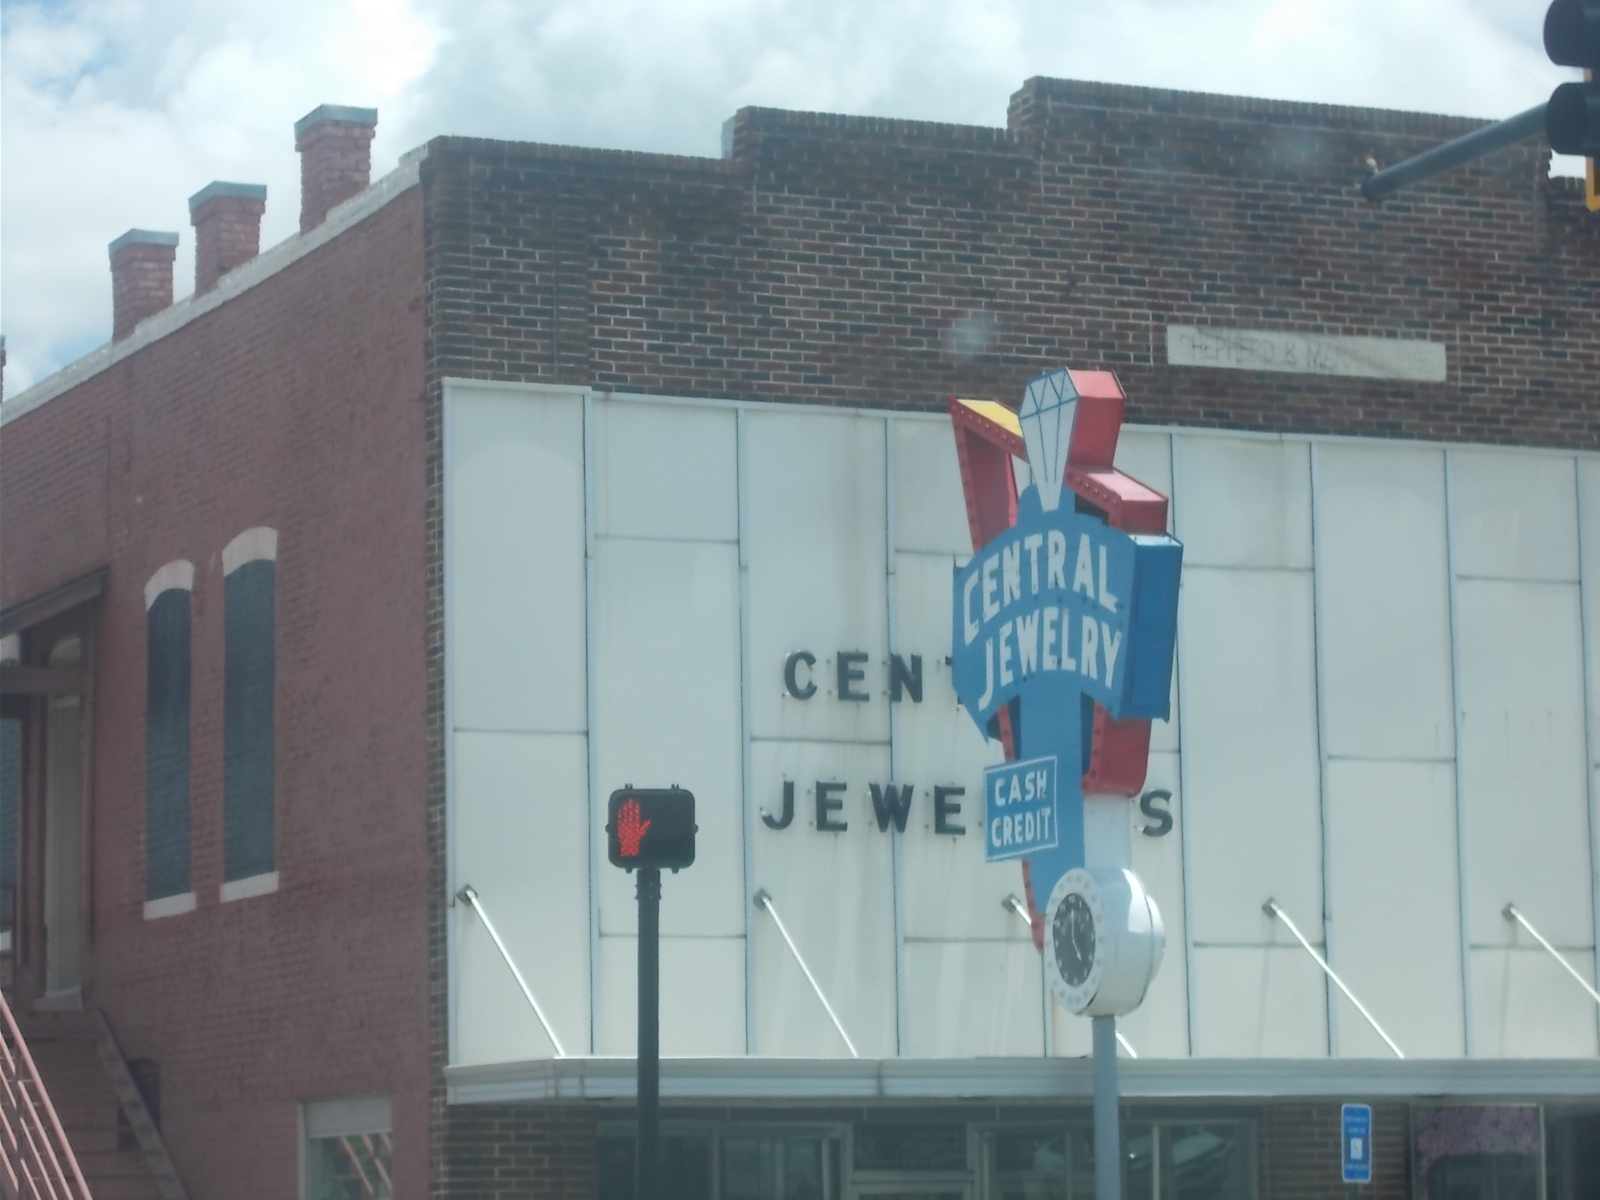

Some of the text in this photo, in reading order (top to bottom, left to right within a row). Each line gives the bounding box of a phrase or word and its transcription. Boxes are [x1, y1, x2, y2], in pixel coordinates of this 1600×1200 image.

[963, 530, 1120, 646] CENTRAL
[783, 650, 954, 703] CEN
[978, 606, 1123, 712] JEWELRY
[994, 769, 1048, 807] CASH
[991, 806, 1052, 848] CREDIT
